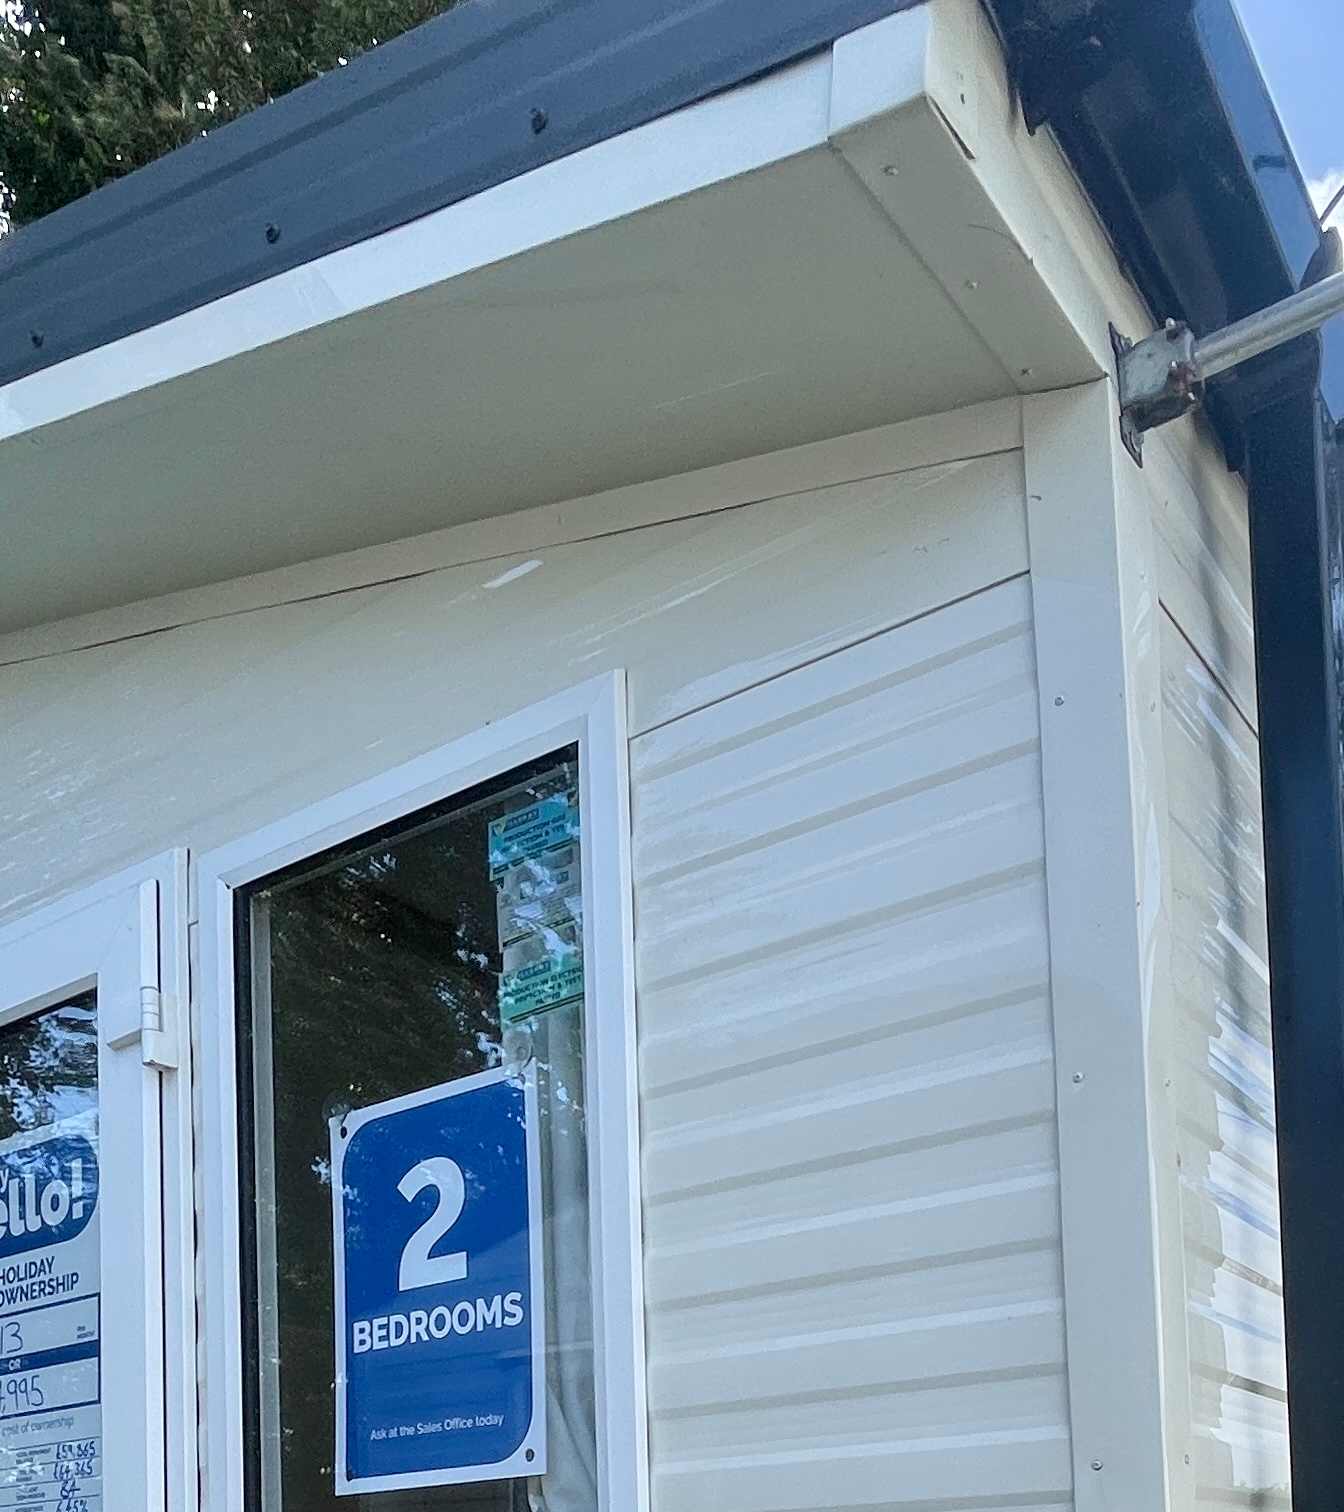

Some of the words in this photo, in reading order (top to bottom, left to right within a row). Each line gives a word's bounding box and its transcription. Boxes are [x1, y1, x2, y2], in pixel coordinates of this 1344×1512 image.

[396, 1156, 469, 1292] 2
[352, 1291, 524, 1354] BEDROOMS
[8, 1359, 22, 1371] OR
[370, 1428, 387, 1441] Ask
[388, 1427, 398, 1438] at
[399, 1425, 415, 1437] the
[416, 1422, 443, 1435] Sales
[444, 1417, 473, 1431] Office
[475, 1414, 504, 1427] today
